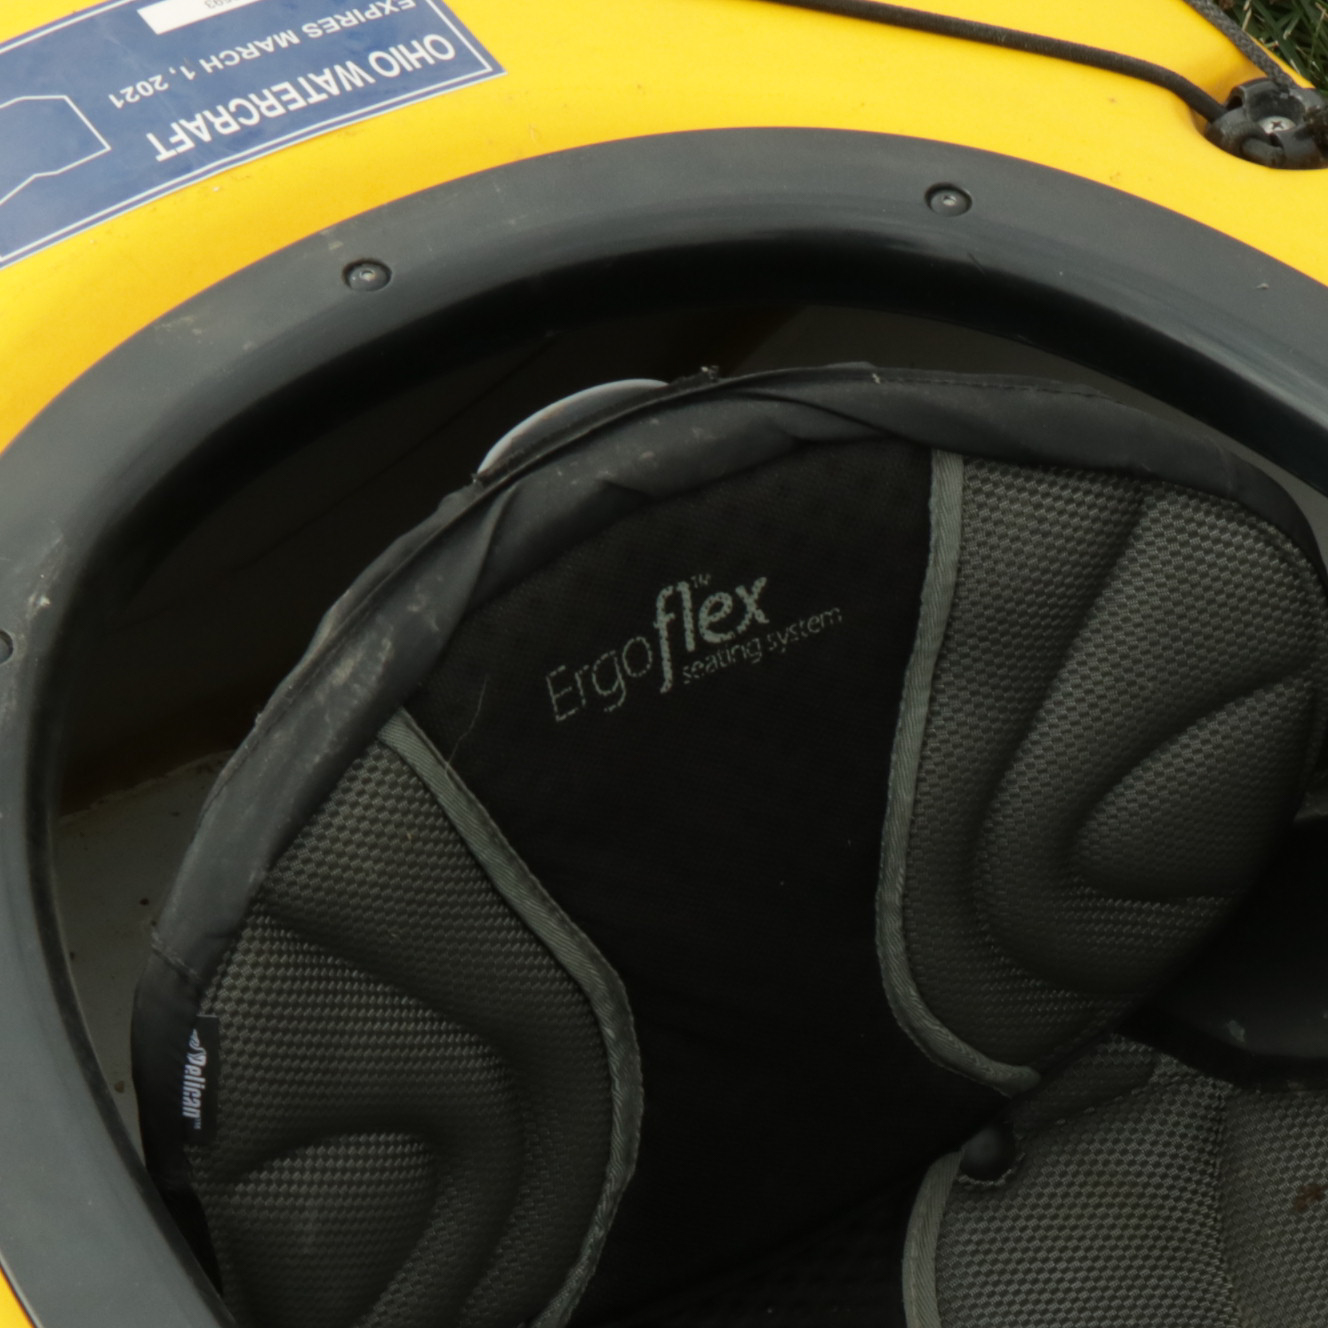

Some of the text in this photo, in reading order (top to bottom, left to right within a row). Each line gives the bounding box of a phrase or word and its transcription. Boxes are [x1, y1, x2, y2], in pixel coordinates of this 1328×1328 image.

[107, 0, 416, 109] EXPIRES MARCH 1, 2021
[146, 33, 455, 162] OHIO WATERCRAFT
[682, 607, 843, 684] seating system
[182, 1029, 207, 1118] Pelican
